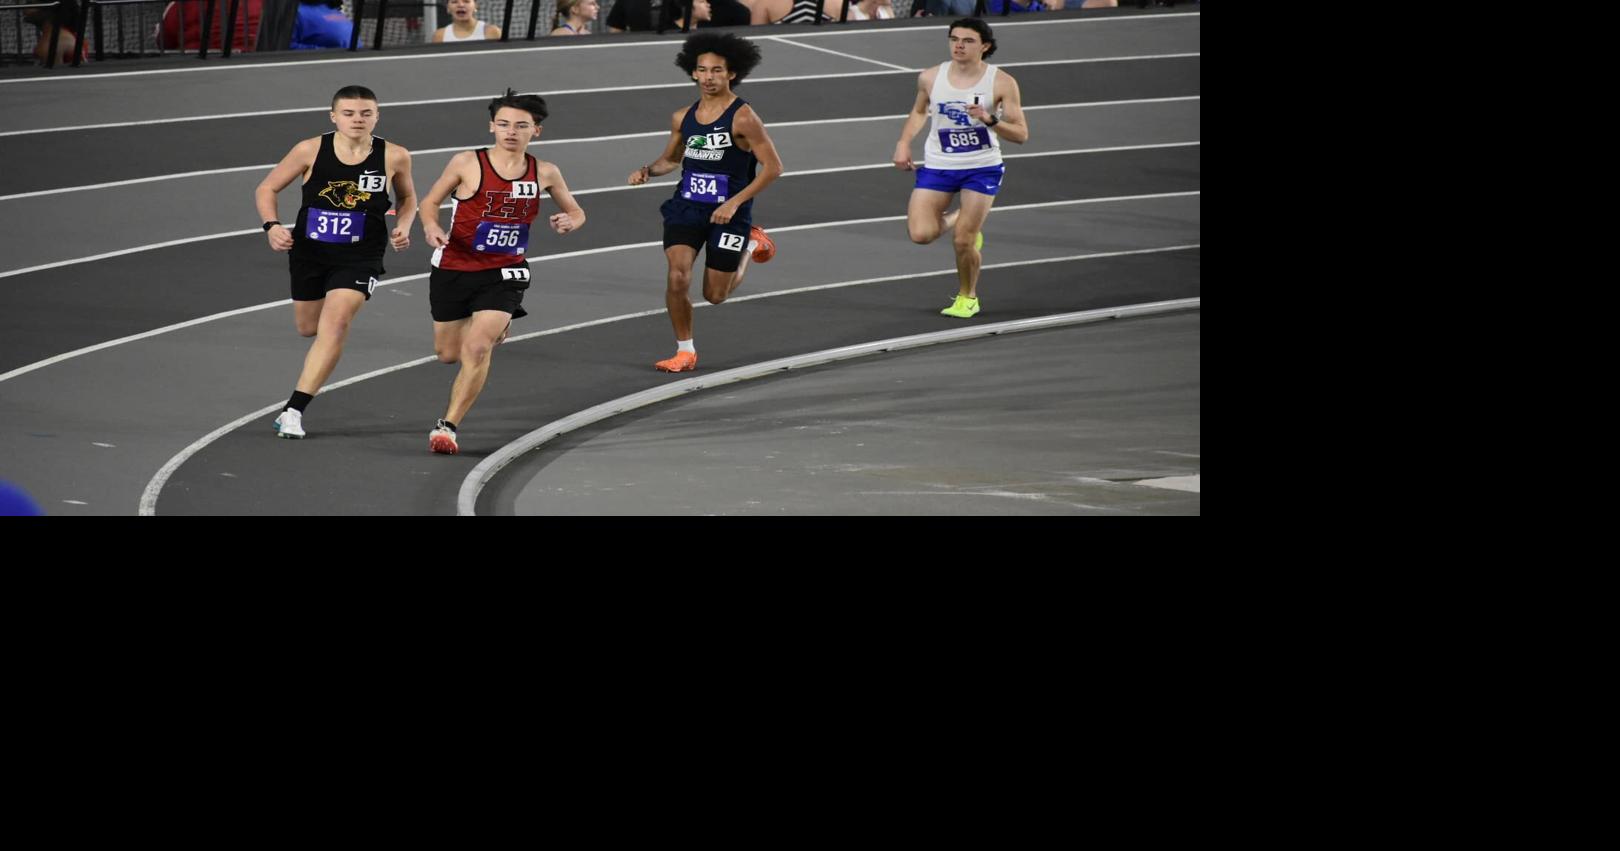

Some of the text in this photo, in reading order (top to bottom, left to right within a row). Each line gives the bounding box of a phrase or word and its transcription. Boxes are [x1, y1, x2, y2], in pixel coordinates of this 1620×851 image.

[708, 134, 729, 146] 12
[948, 132, 980, 147] 685
[361, 177, 383, 189] 13
[518, 183, 534, 196] 11
[690, 177, 718, 195] 534
[317, 215, 352, 235] 312
[486, 228, 520, 247] 556
[723, 234, 742, 248] 12
[508, 270, 527, 280] 11
